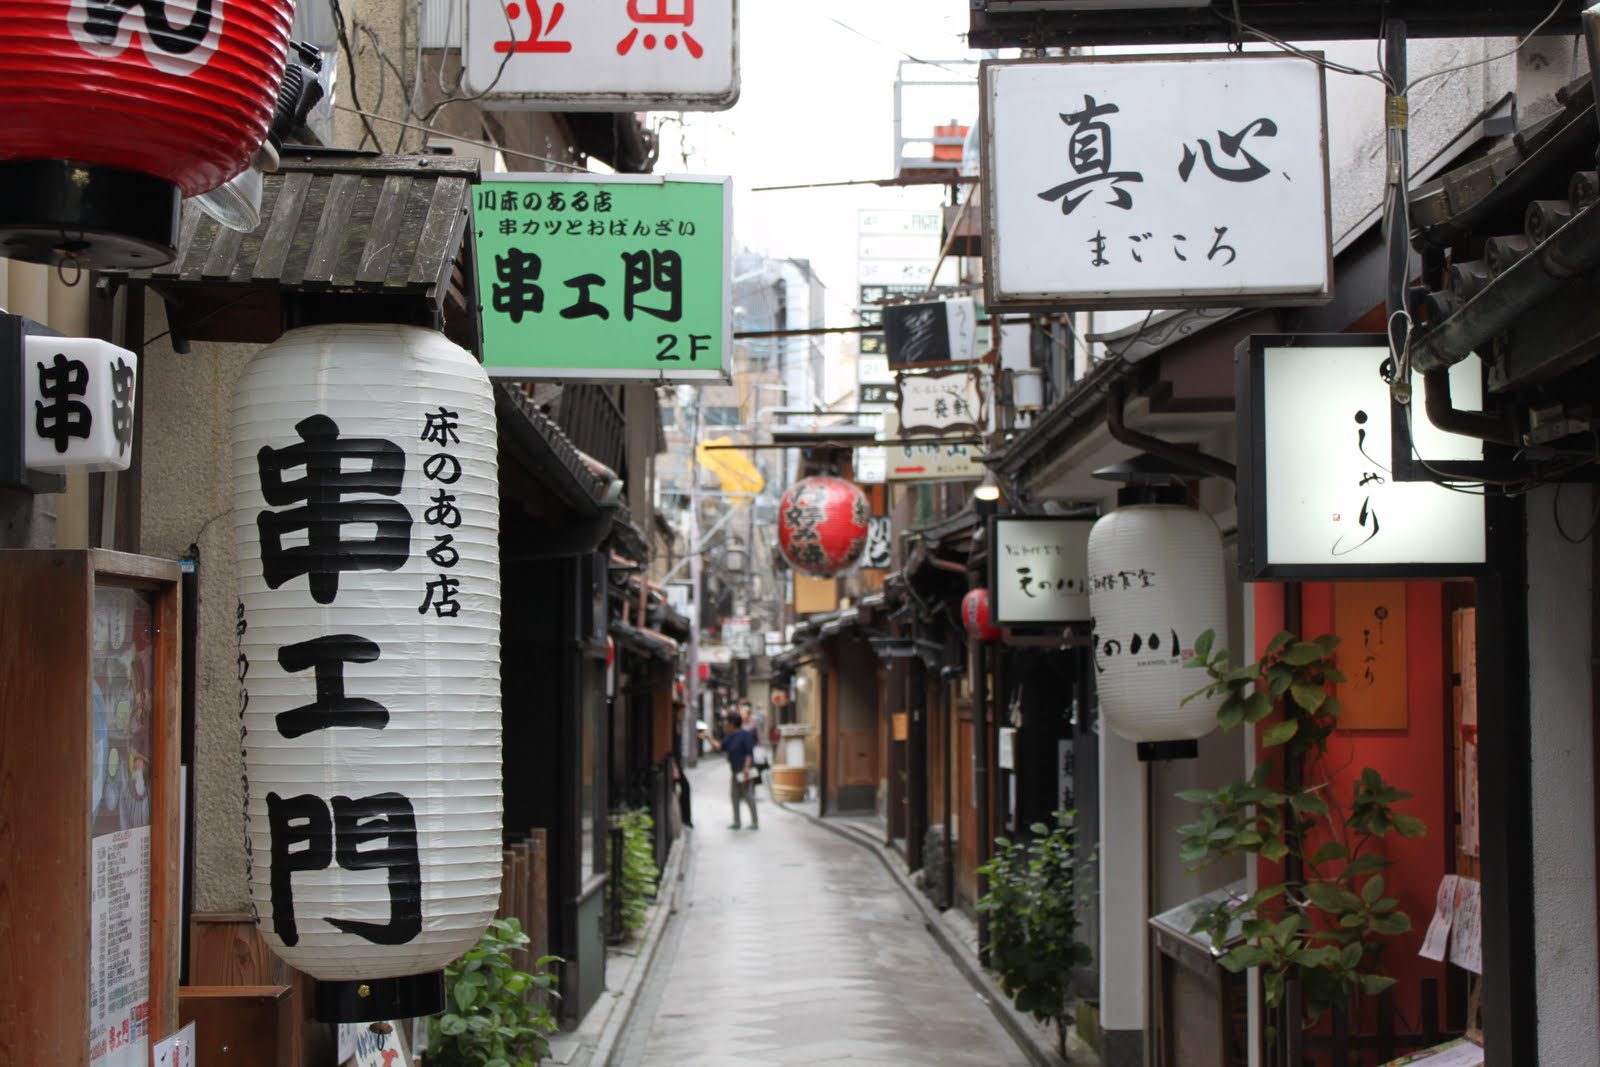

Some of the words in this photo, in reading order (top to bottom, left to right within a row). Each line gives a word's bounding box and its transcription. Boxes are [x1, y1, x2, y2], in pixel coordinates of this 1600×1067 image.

[1037, 94, 1278, 215] 真心
[499, 219, 696, 236] 串カツとおばんざい
[1087, 226, 1236, 267] まごころ
[656, 334, 712, 361] 2F
[35, 353, 93, 453] 串
[418, 407, 462, 618] 床のある店
